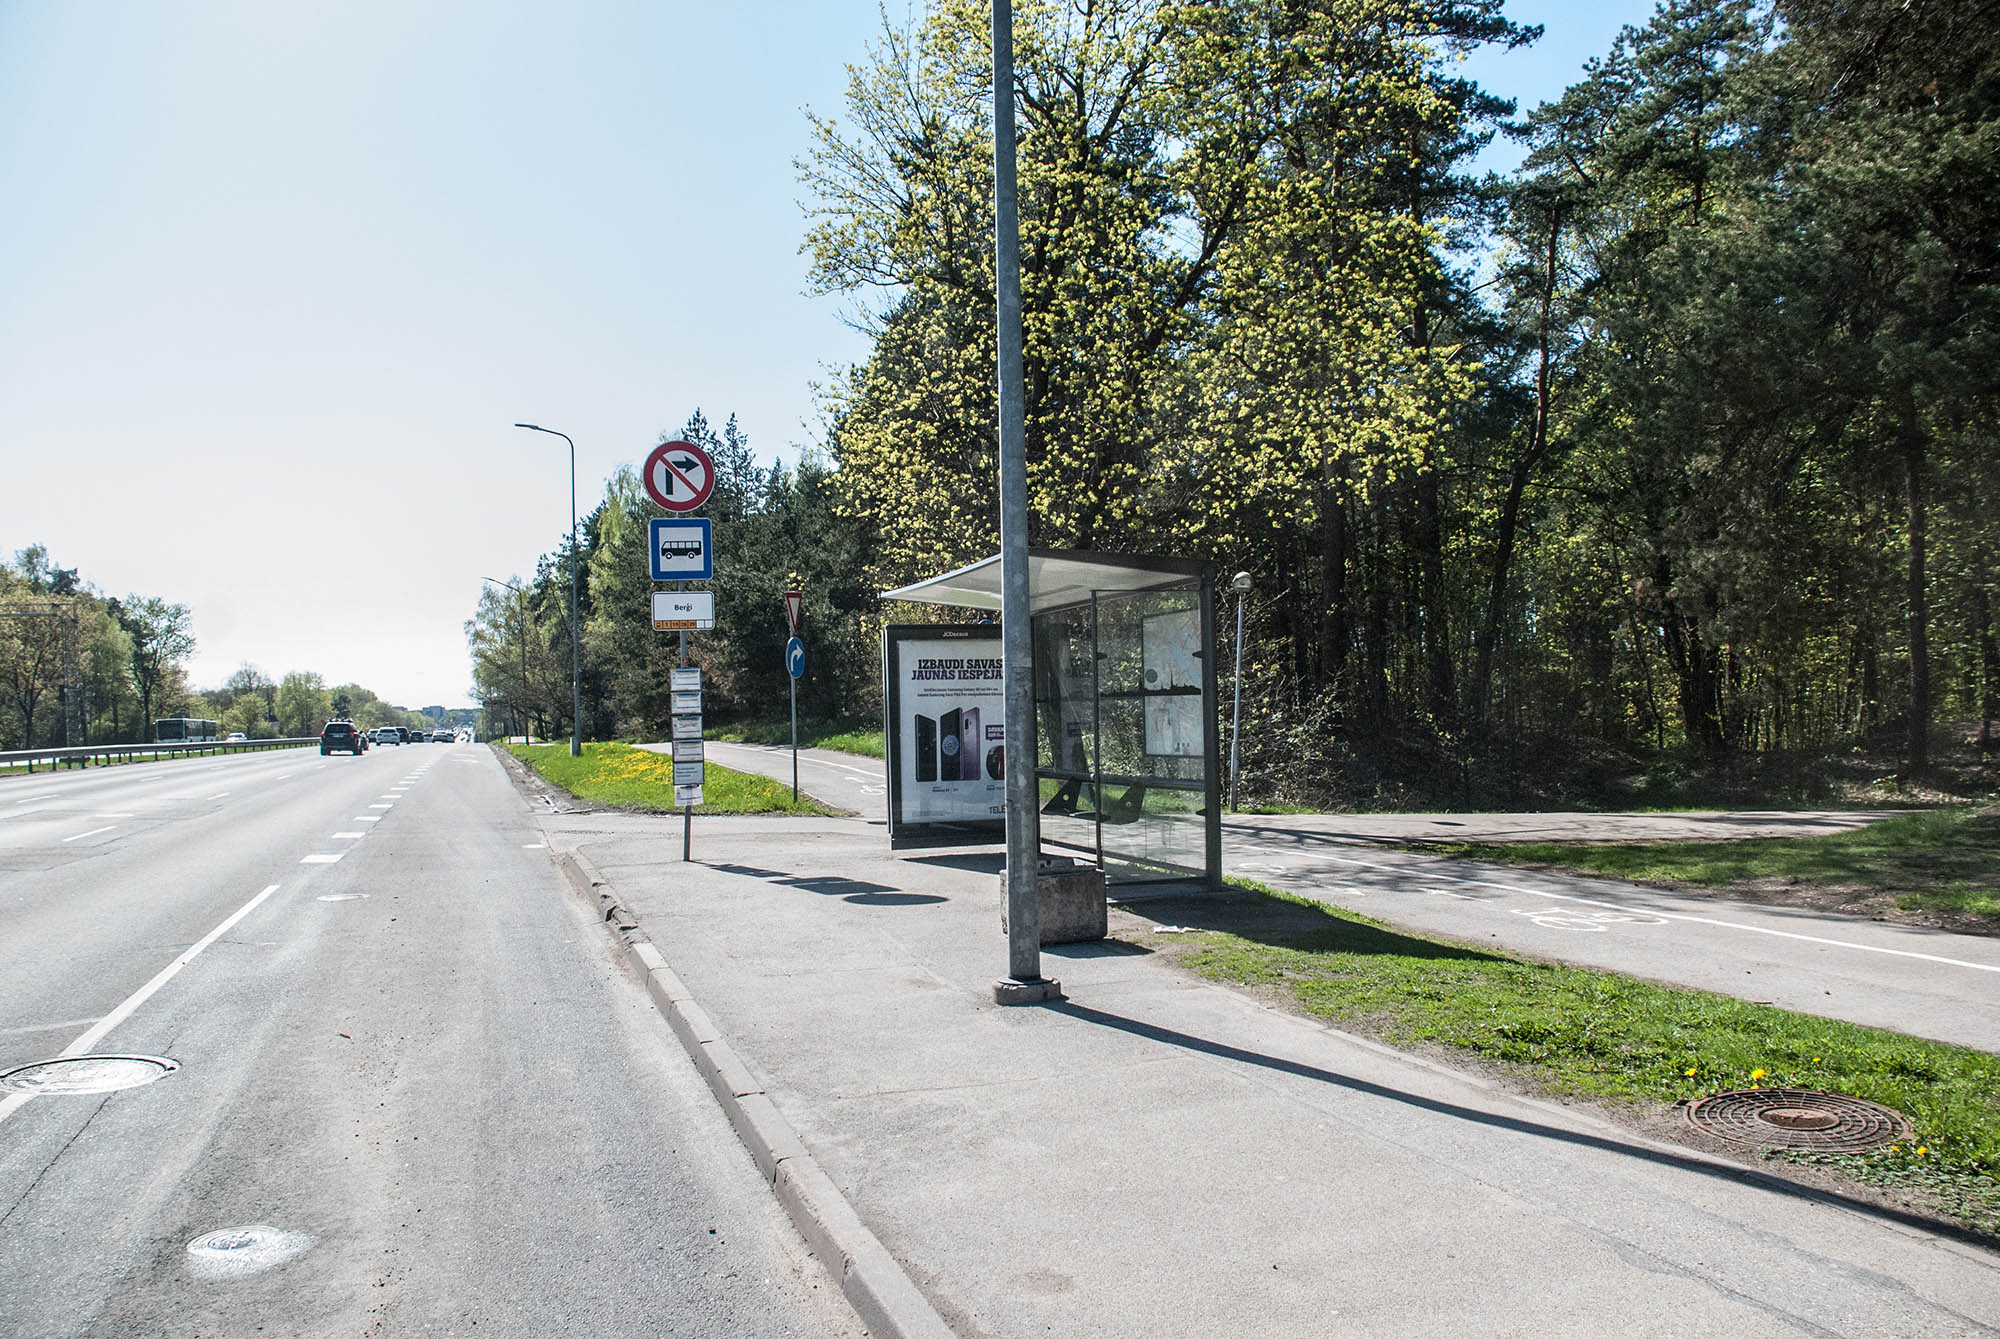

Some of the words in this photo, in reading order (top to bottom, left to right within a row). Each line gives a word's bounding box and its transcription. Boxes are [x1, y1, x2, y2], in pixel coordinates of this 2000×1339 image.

[674, 603, 693, 612] Berģi
[918, 659, 965, 669] IZBAUDI
[967, 659, 1003, 669] SAVAS
[911, 669, 956, 680] JAUNĀS
[957, 669, 1004, 680] IESPĒJA
[988, 805, 1005, 815] TELE
